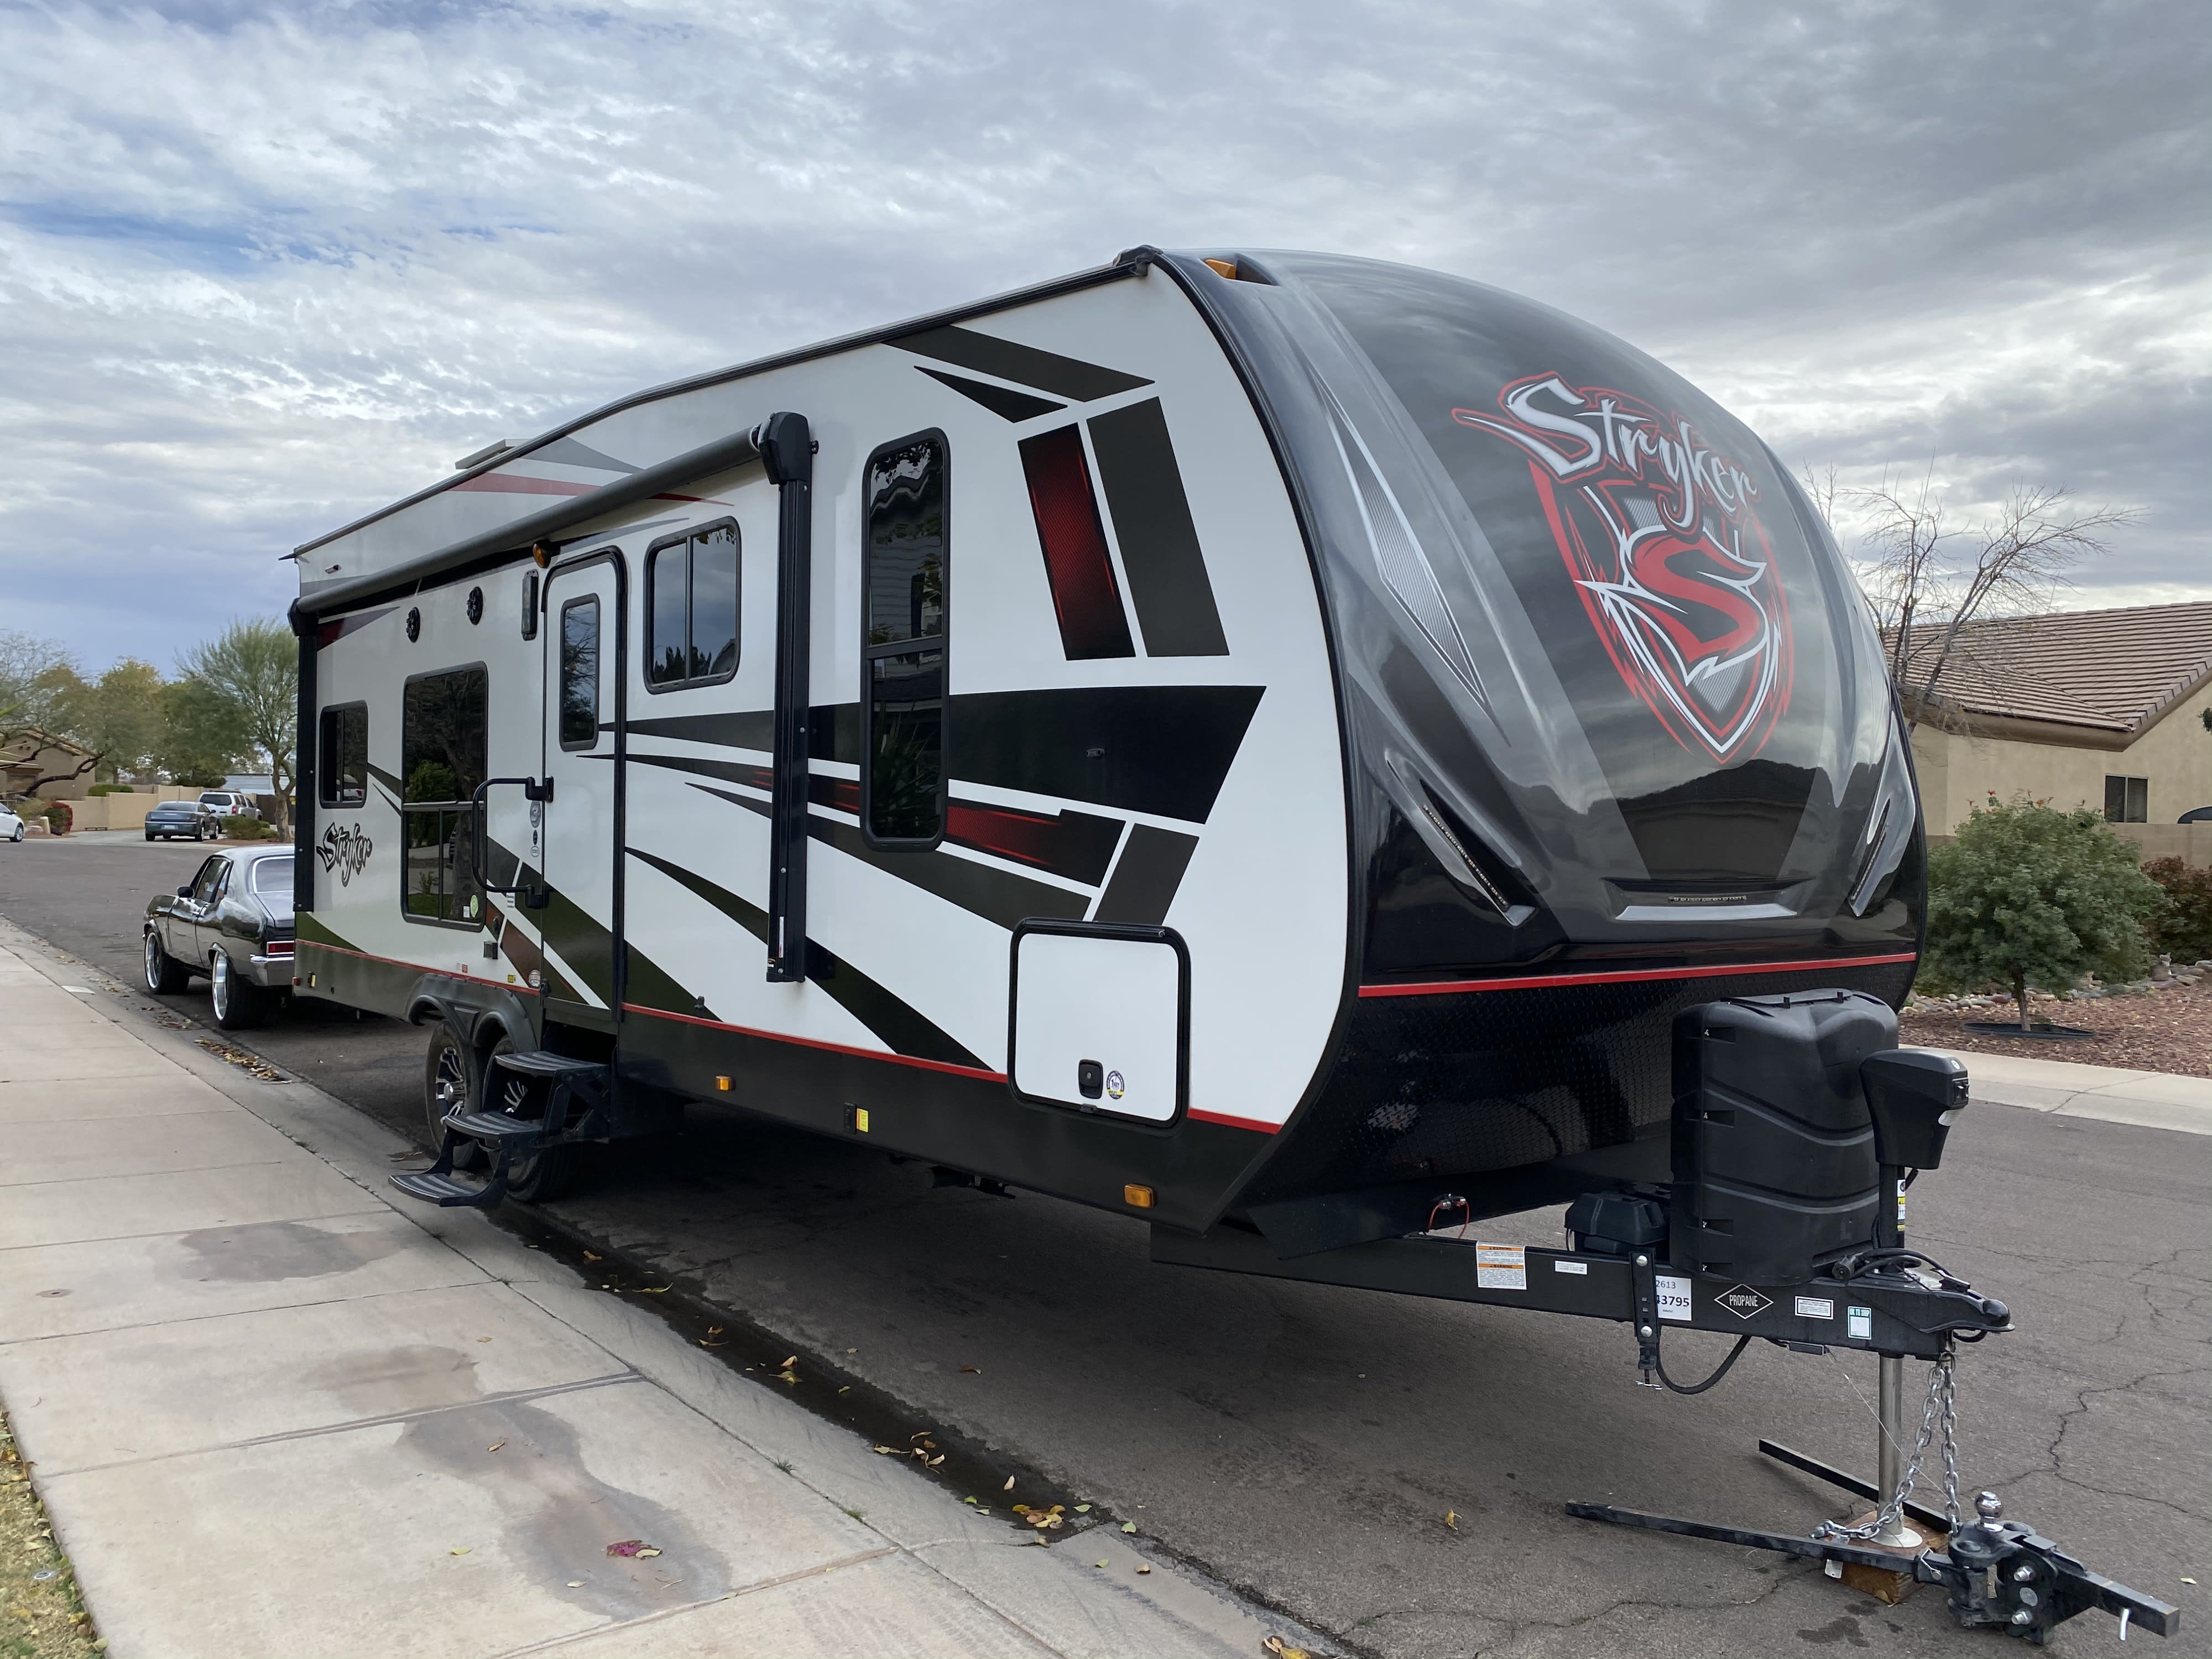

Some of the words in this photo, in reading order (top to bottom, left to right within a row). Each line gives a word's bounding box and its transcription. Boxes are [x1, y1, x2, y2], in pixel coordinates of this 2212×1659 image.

[1459, 376, 1759, 530] Stryker
[316, 822, 373, 887] Stryker
[1729, 1294, 1759, 1307] PROPANE
